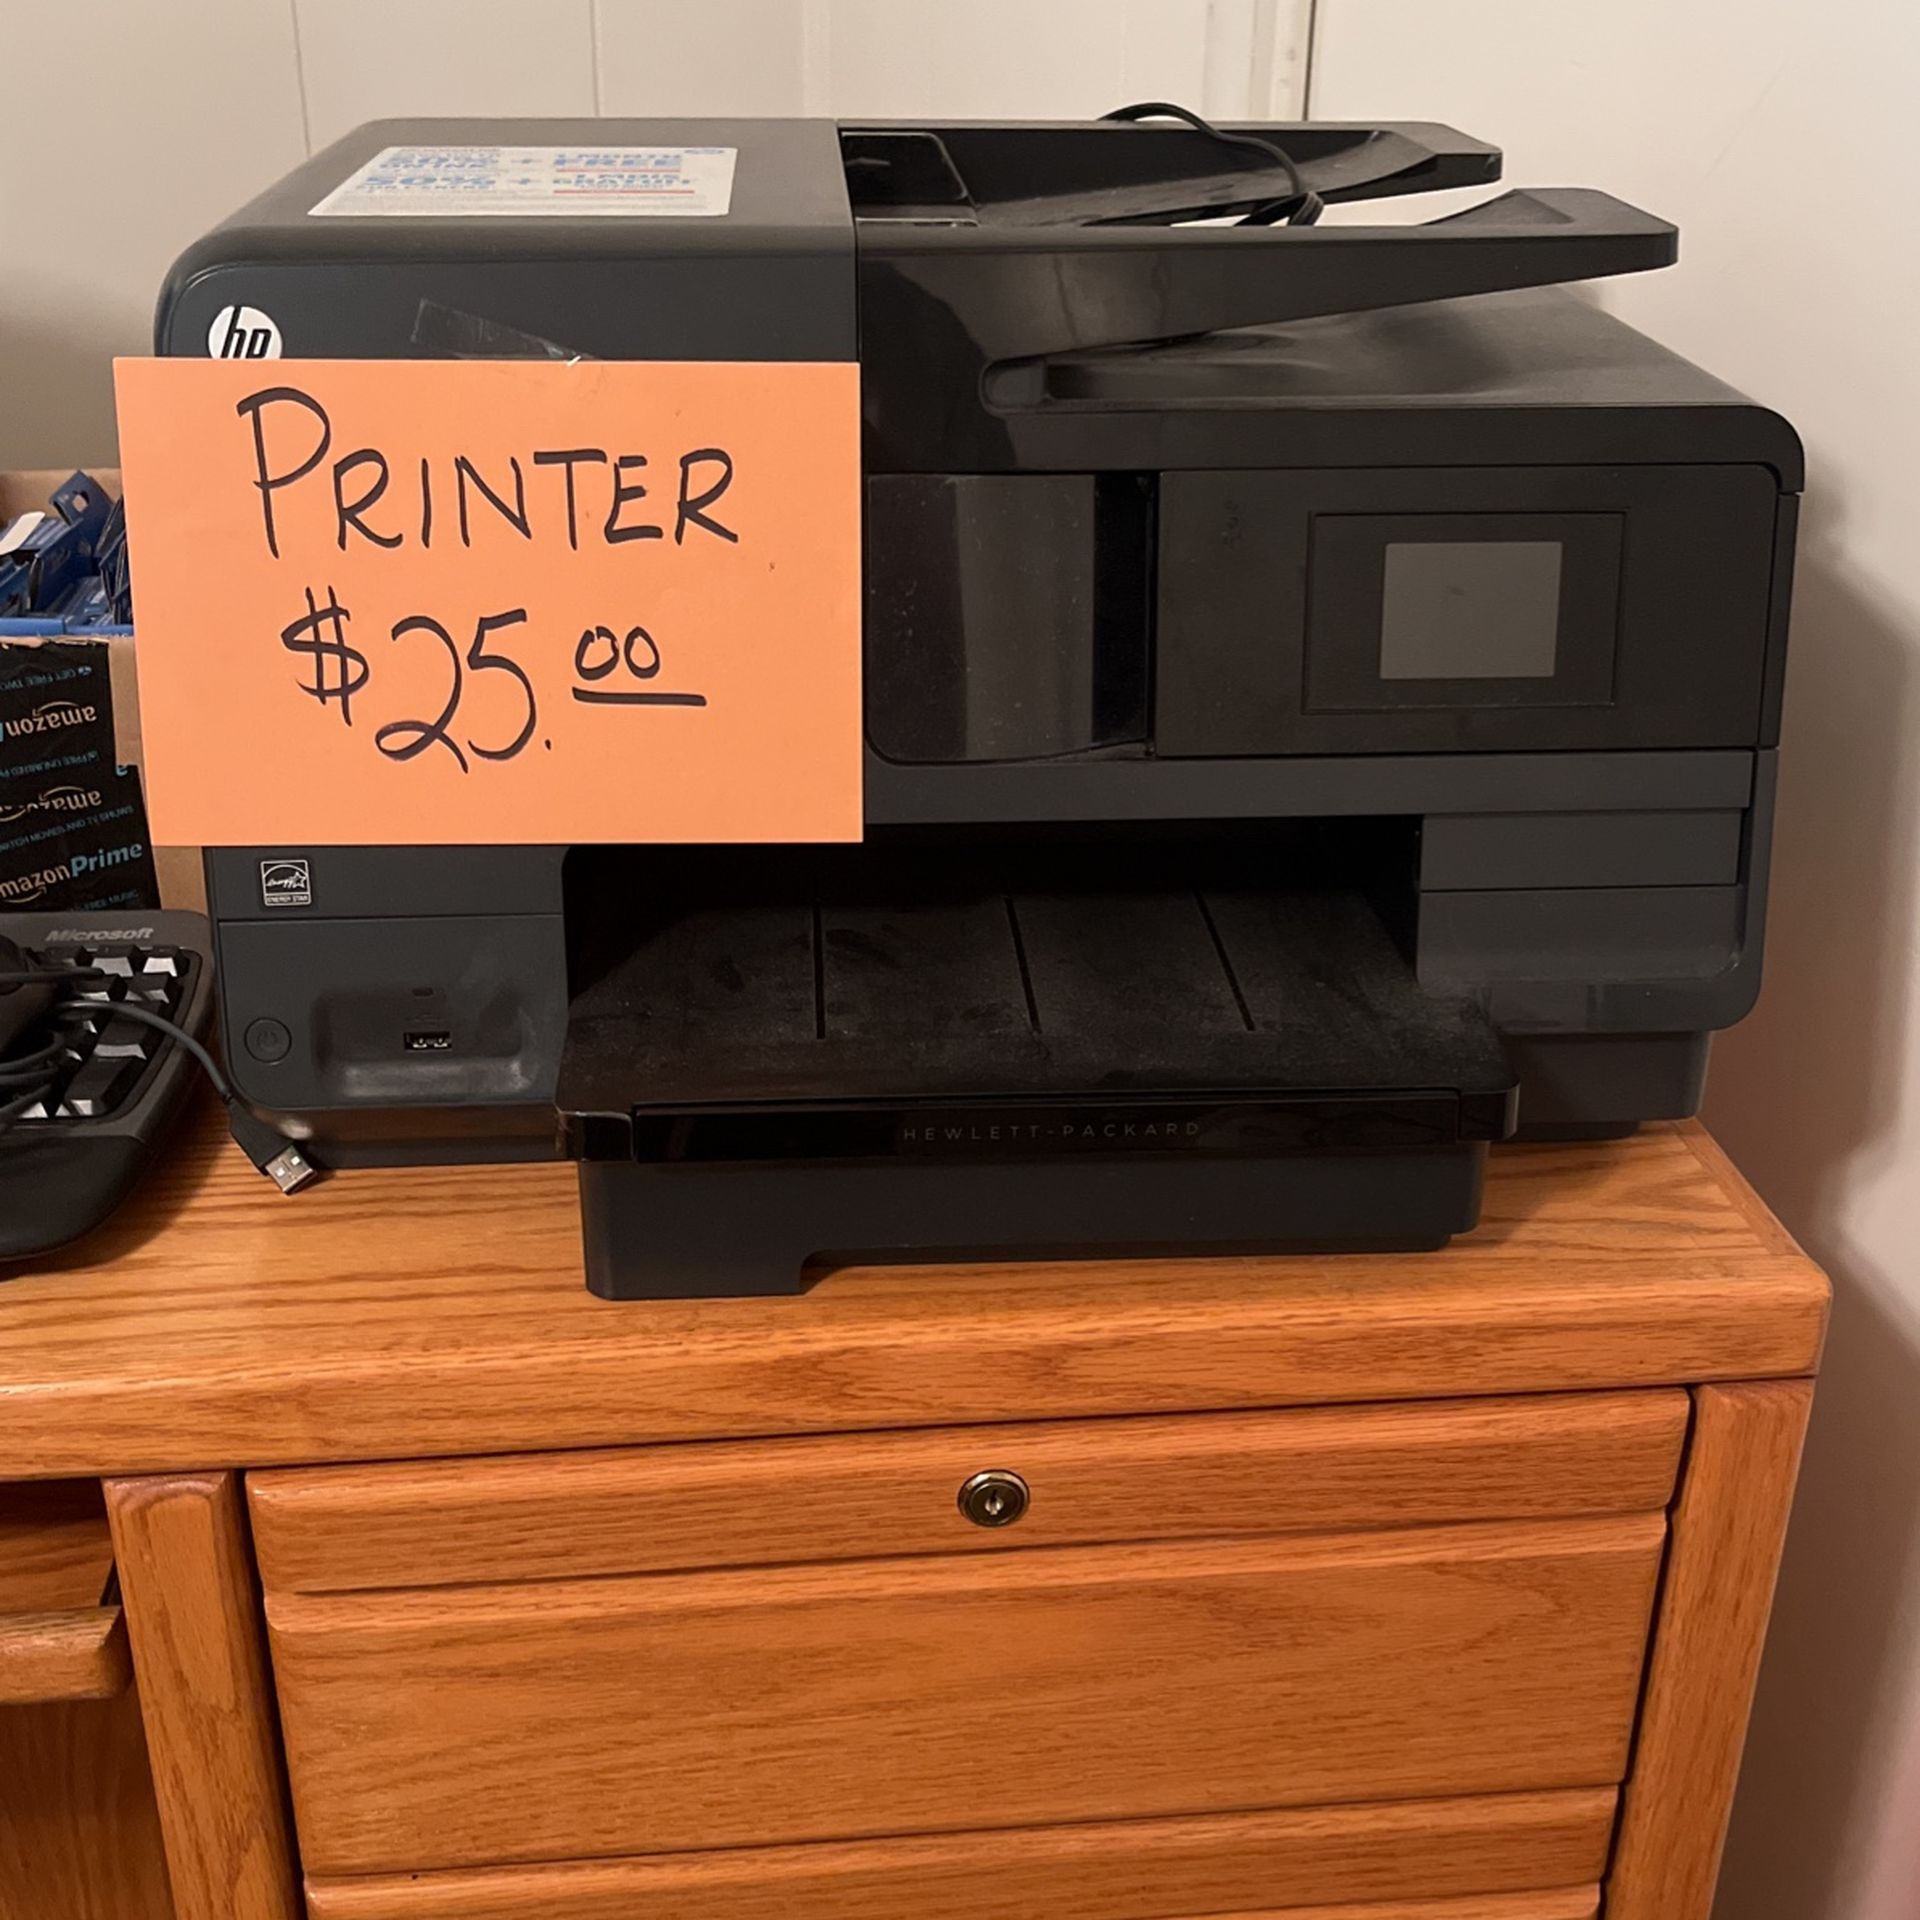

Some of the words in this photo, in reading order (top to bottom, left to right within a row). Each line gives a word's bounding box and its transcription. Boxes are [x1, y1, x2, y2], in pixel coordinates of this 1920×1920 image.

[236, 386, 739, 559] PRINTER
[45, 926, 154, 943] Microsoft
[903, 1121, 1200, 1142] HEWLETT-PACKARD
